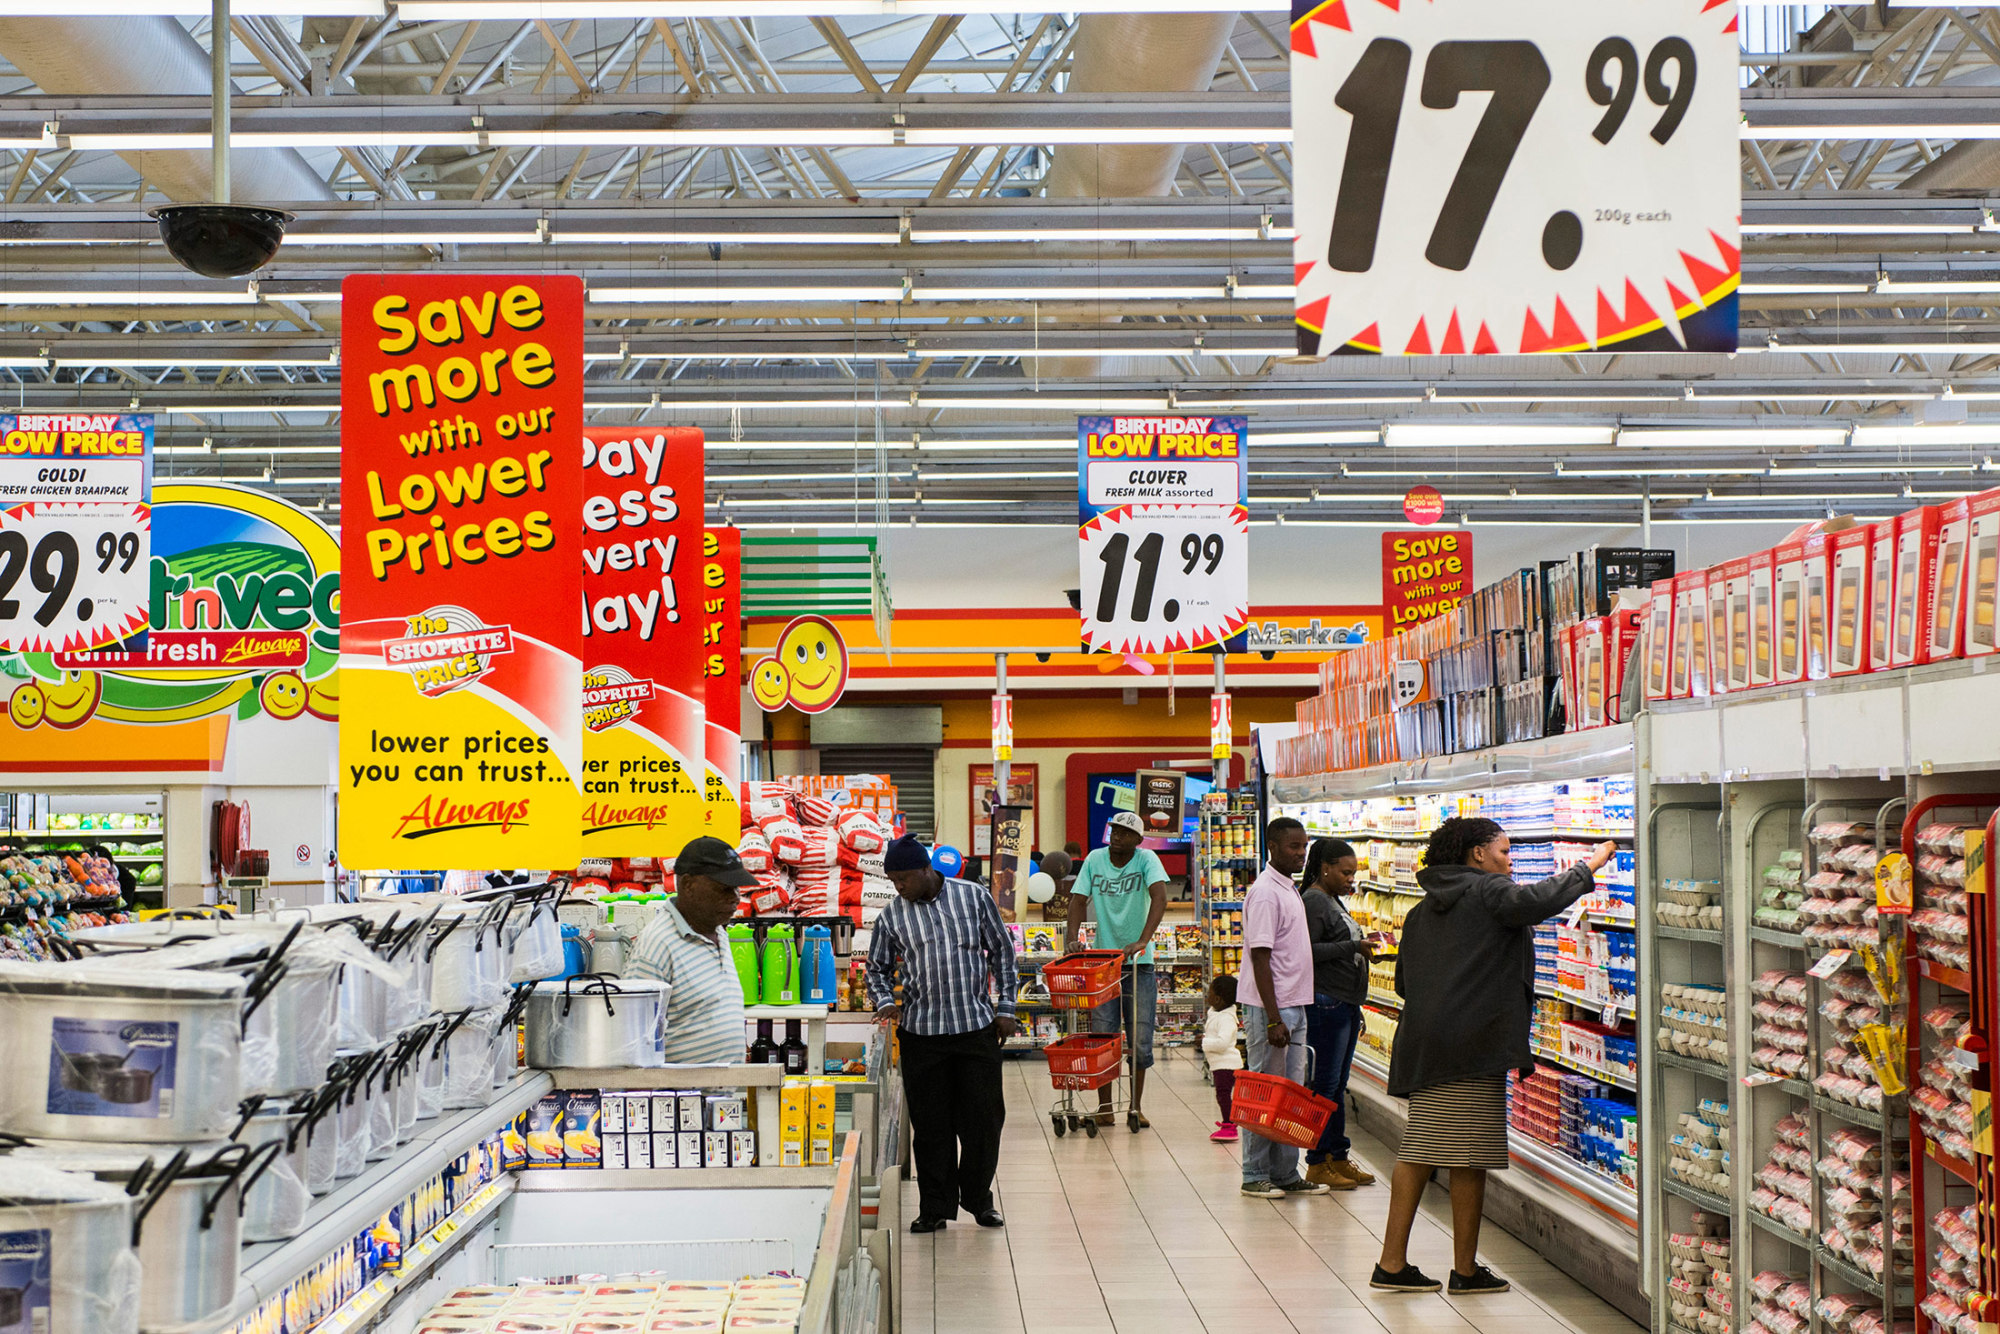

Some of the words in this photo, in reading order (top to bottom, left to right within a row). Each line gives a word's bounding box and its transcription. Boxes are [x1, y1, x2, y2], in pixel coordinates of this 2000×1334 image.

[1595, 209, 1631, 224] 200g
[1636, 209, 1671, 222] each
[373, 285, 543, 354] Save
[369, 342, 555, 416] more
[19, 416, 118, 431] BIRTHDAY
[400, 415, 481, 458] with
[496, 406, 554, 439] our
[1115, 418, 1212, 434] BIRTHDAY
[64, 432, 142, 454] PRICE
[1089, 434, 1153, 456] LOW
[1159, 434, 1237, 456] PRICE
[38, 468, 86, 482] GOLDI
[366, 450, 551, 521] Lower
[1129, 470, 1187, 485] CLOVER
[0, 485, 28, 495] FRESH
[30, 485, 73, 495] CHICKEN
[75, 486, 129, 496] BRAAIPACK
[1105, 488, 1134, 497] FRESH
[1138, 488, 1162, 497] MILK
[1165, 488, 1213, 497] assorted
[583, 485, 679, 531] ess
[366, 511, 555, 581] Prices
[583, 534, 678, 573] very
[1393, 534, 1458, 562] Save
[1392, 556, 1463, 585] more
[1404, 584, 1435, 600] with
[1440, 579, 1463, 594] our
[1392, 596, 1462, 624] Lower
[408, 615, 448, 636] The
[1248, 620, 1368, 645] Market
[148, 637, 216, 662] fresh
[222, 637, 302, 663] Always
[388, 632, 506, 661] SHOPRITE
[415, 653, 481, 690] PRICE
[583, 684, 649, 704] HOPRITE
[583, 699, 631, 728] PRICE
[372, 730, 449, 752] lower
[465, 731, 549, 759] prices
[351, 765, 399, 788] you
[415, 765, 463, 782] can
[479, 761, 570, 782] trust...
[620, 756, 681, 776] prices
[584, 780, 619, 793] can
[630, 777, 696, 794] trust...
[392, 794, 529, 839] Always
[583, 801, 668, 830] Always
[996, 835, 1025, 849] Meg
[860, 859, 885, 868] POTATO
[863, 892, 895, 900] POTATOES
[567, 1099, 597, 1111] Classic
